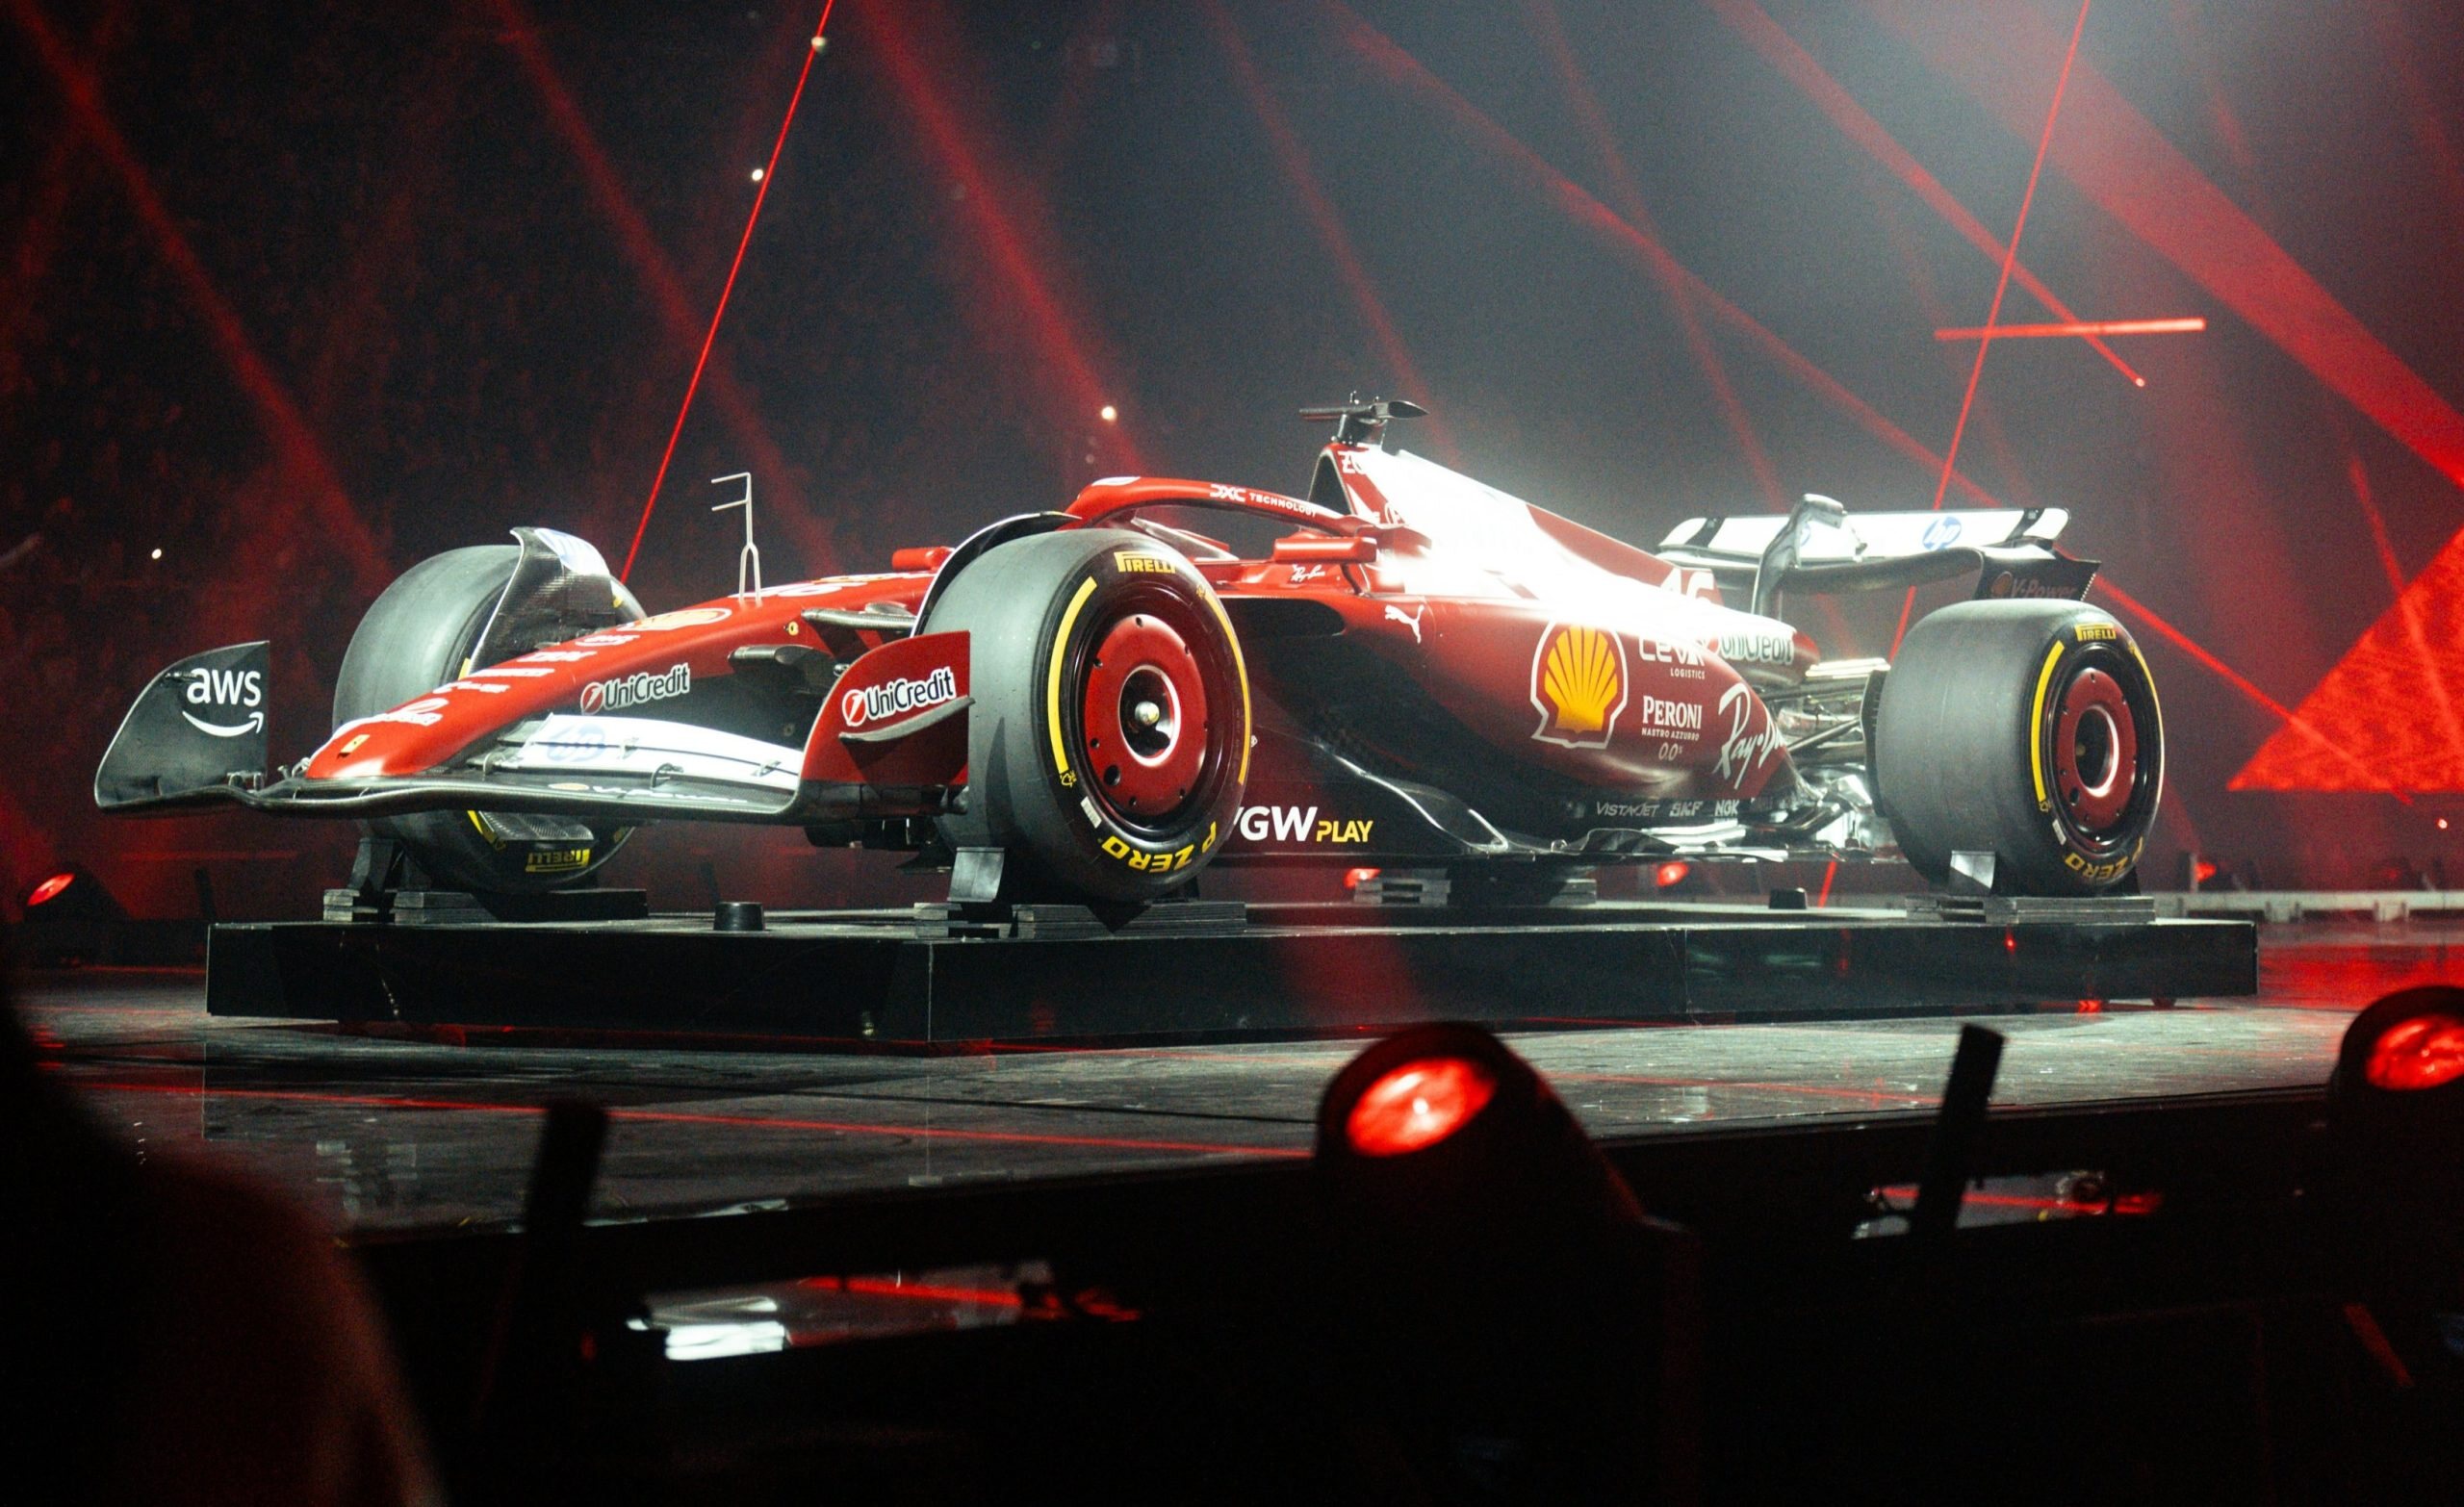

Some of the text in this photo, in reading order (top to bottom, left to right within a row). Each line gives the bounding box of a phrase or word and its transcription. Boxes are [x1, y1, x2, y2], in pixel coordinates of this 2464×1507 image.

[1210, 483, 1317, 518] DXC TECHNOLOGY
[1114, 550, 1176, 574] PIRELLI
[2074, 623, 2118, 642] PIRELLI
[187, 667, 262, 707] aws
[603, 664, 689, 710] UniCredit
[1670, 668, 1706, 679] LOGISTICS
[866, 668, 956, 718] UniCredit
[1642, 695, 1703, 729] PERONI
[1641, 728, 1700, 741] NASTRO AZZURRO
[1714, 800, 1740, 817] NGK
[1316, 820, 1373, 843] PLAY
[1101, 835, 1194, 873] ZERO
